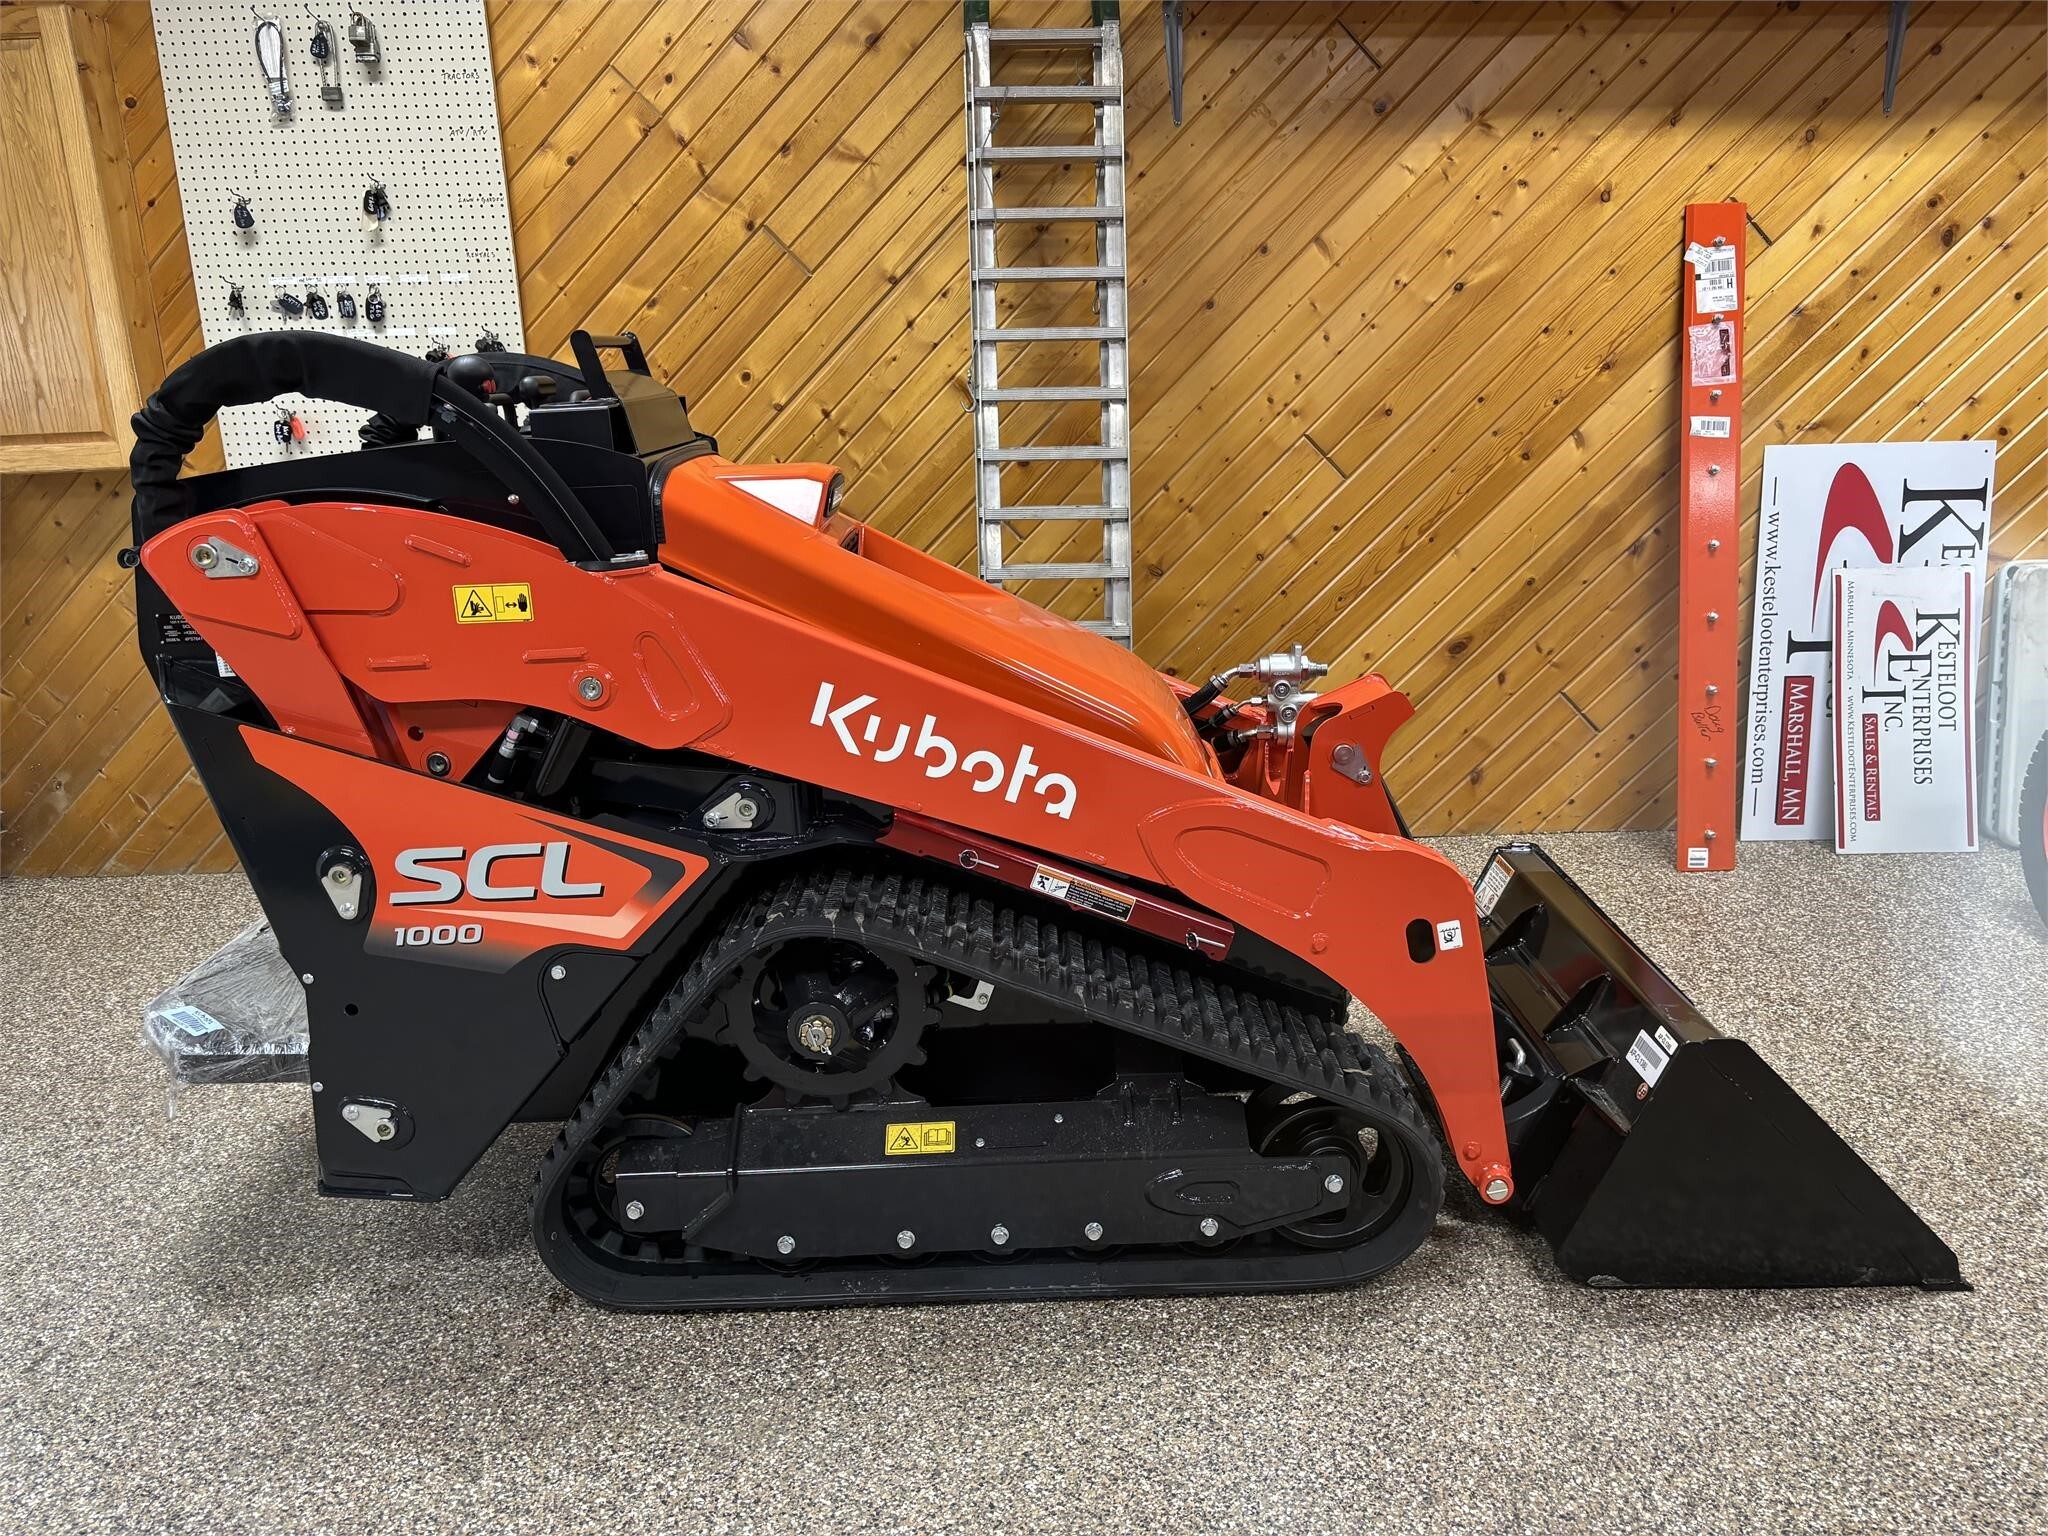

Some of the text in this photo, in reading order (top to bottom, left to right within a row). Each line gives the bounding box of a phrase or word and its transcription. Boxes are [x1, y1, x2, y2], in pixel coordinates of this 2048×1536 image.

[441, 72, 480, 80] TRACTORS
[1751, 511, 1782, 784] www.kestelootenterprises.com
[1847, 630, 1855, 680] MINNESOTA
[1915, 607, 1960, 731] KESTELOOT
[810, 681, 1077, 820] Kubota
[1781, 683, 1809, 821] MARSHALL, MN
[1862, 685, 1906, 732] INC.
[1887, 649, 1933, 785] ENTERPRISES
[1864, 717, 1877, 819] SALES & RENTALS
[389, 842, 605, 905] SCL
[394, 923, 484, 947] 1000
